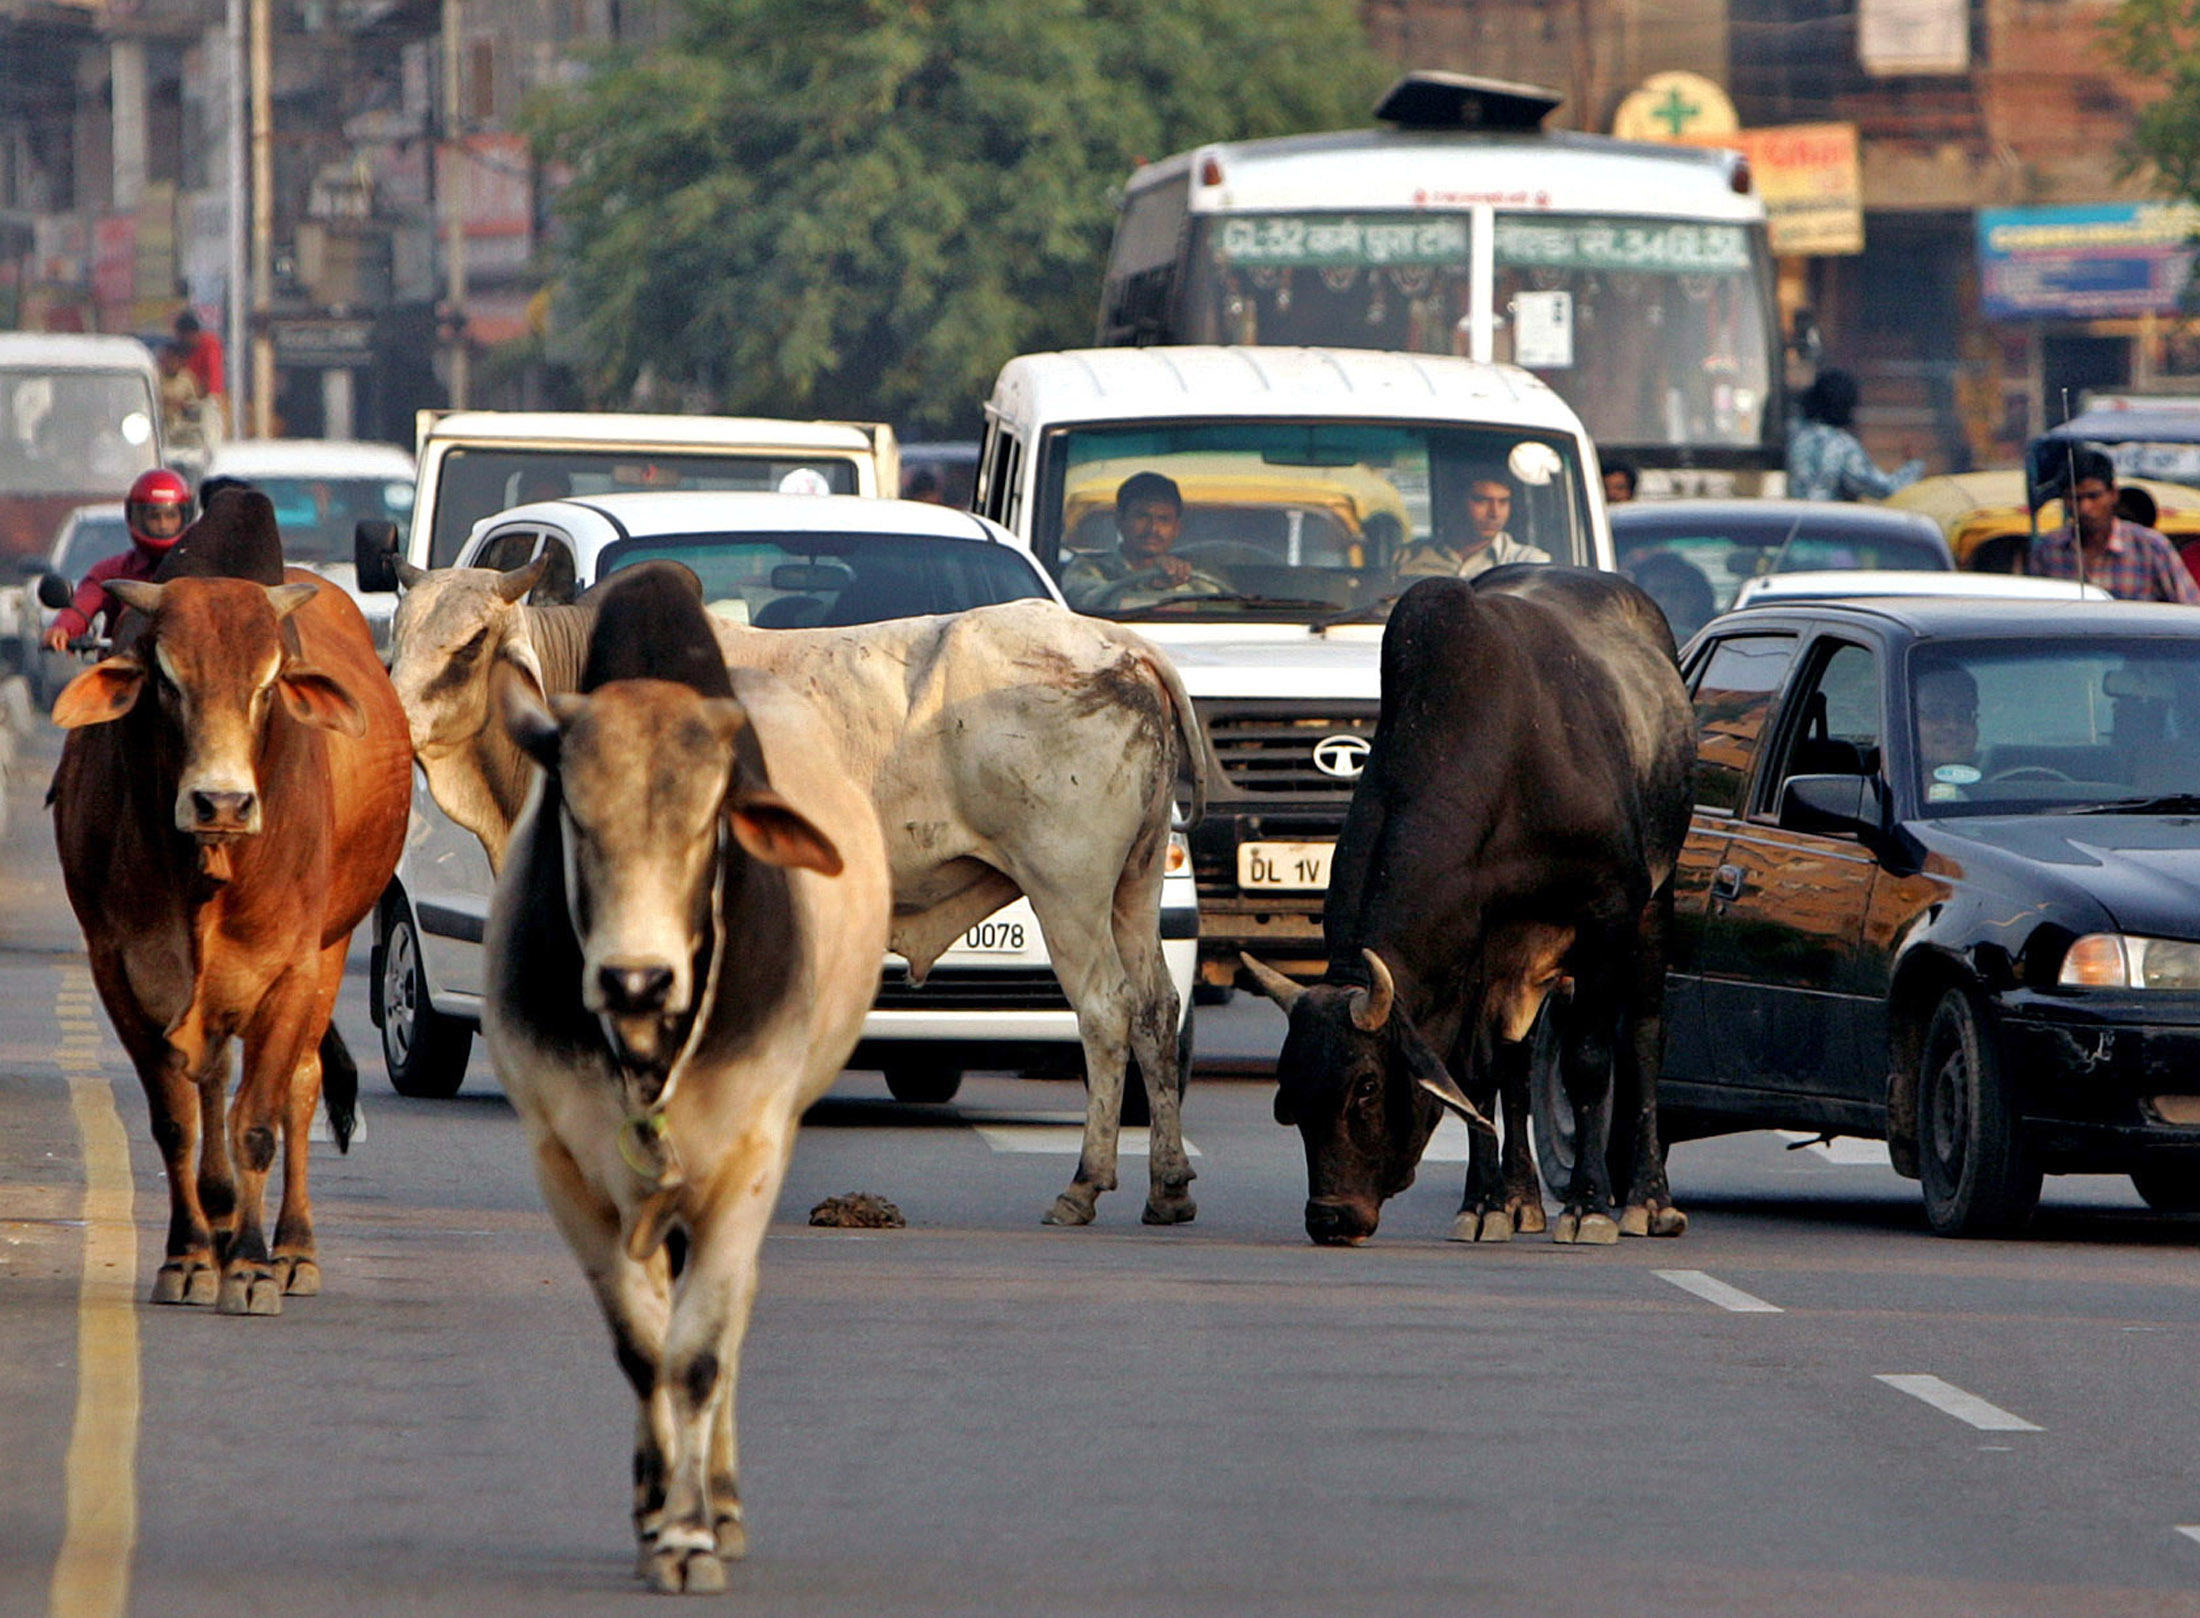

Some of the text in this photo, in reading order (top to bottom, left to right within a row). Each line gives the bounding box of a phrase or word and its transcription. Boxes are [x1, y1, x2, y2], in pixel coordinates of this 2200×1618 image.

[1251, 858, 1320, 883] DL 1V
[966, 923, 1025, 949] 0078
